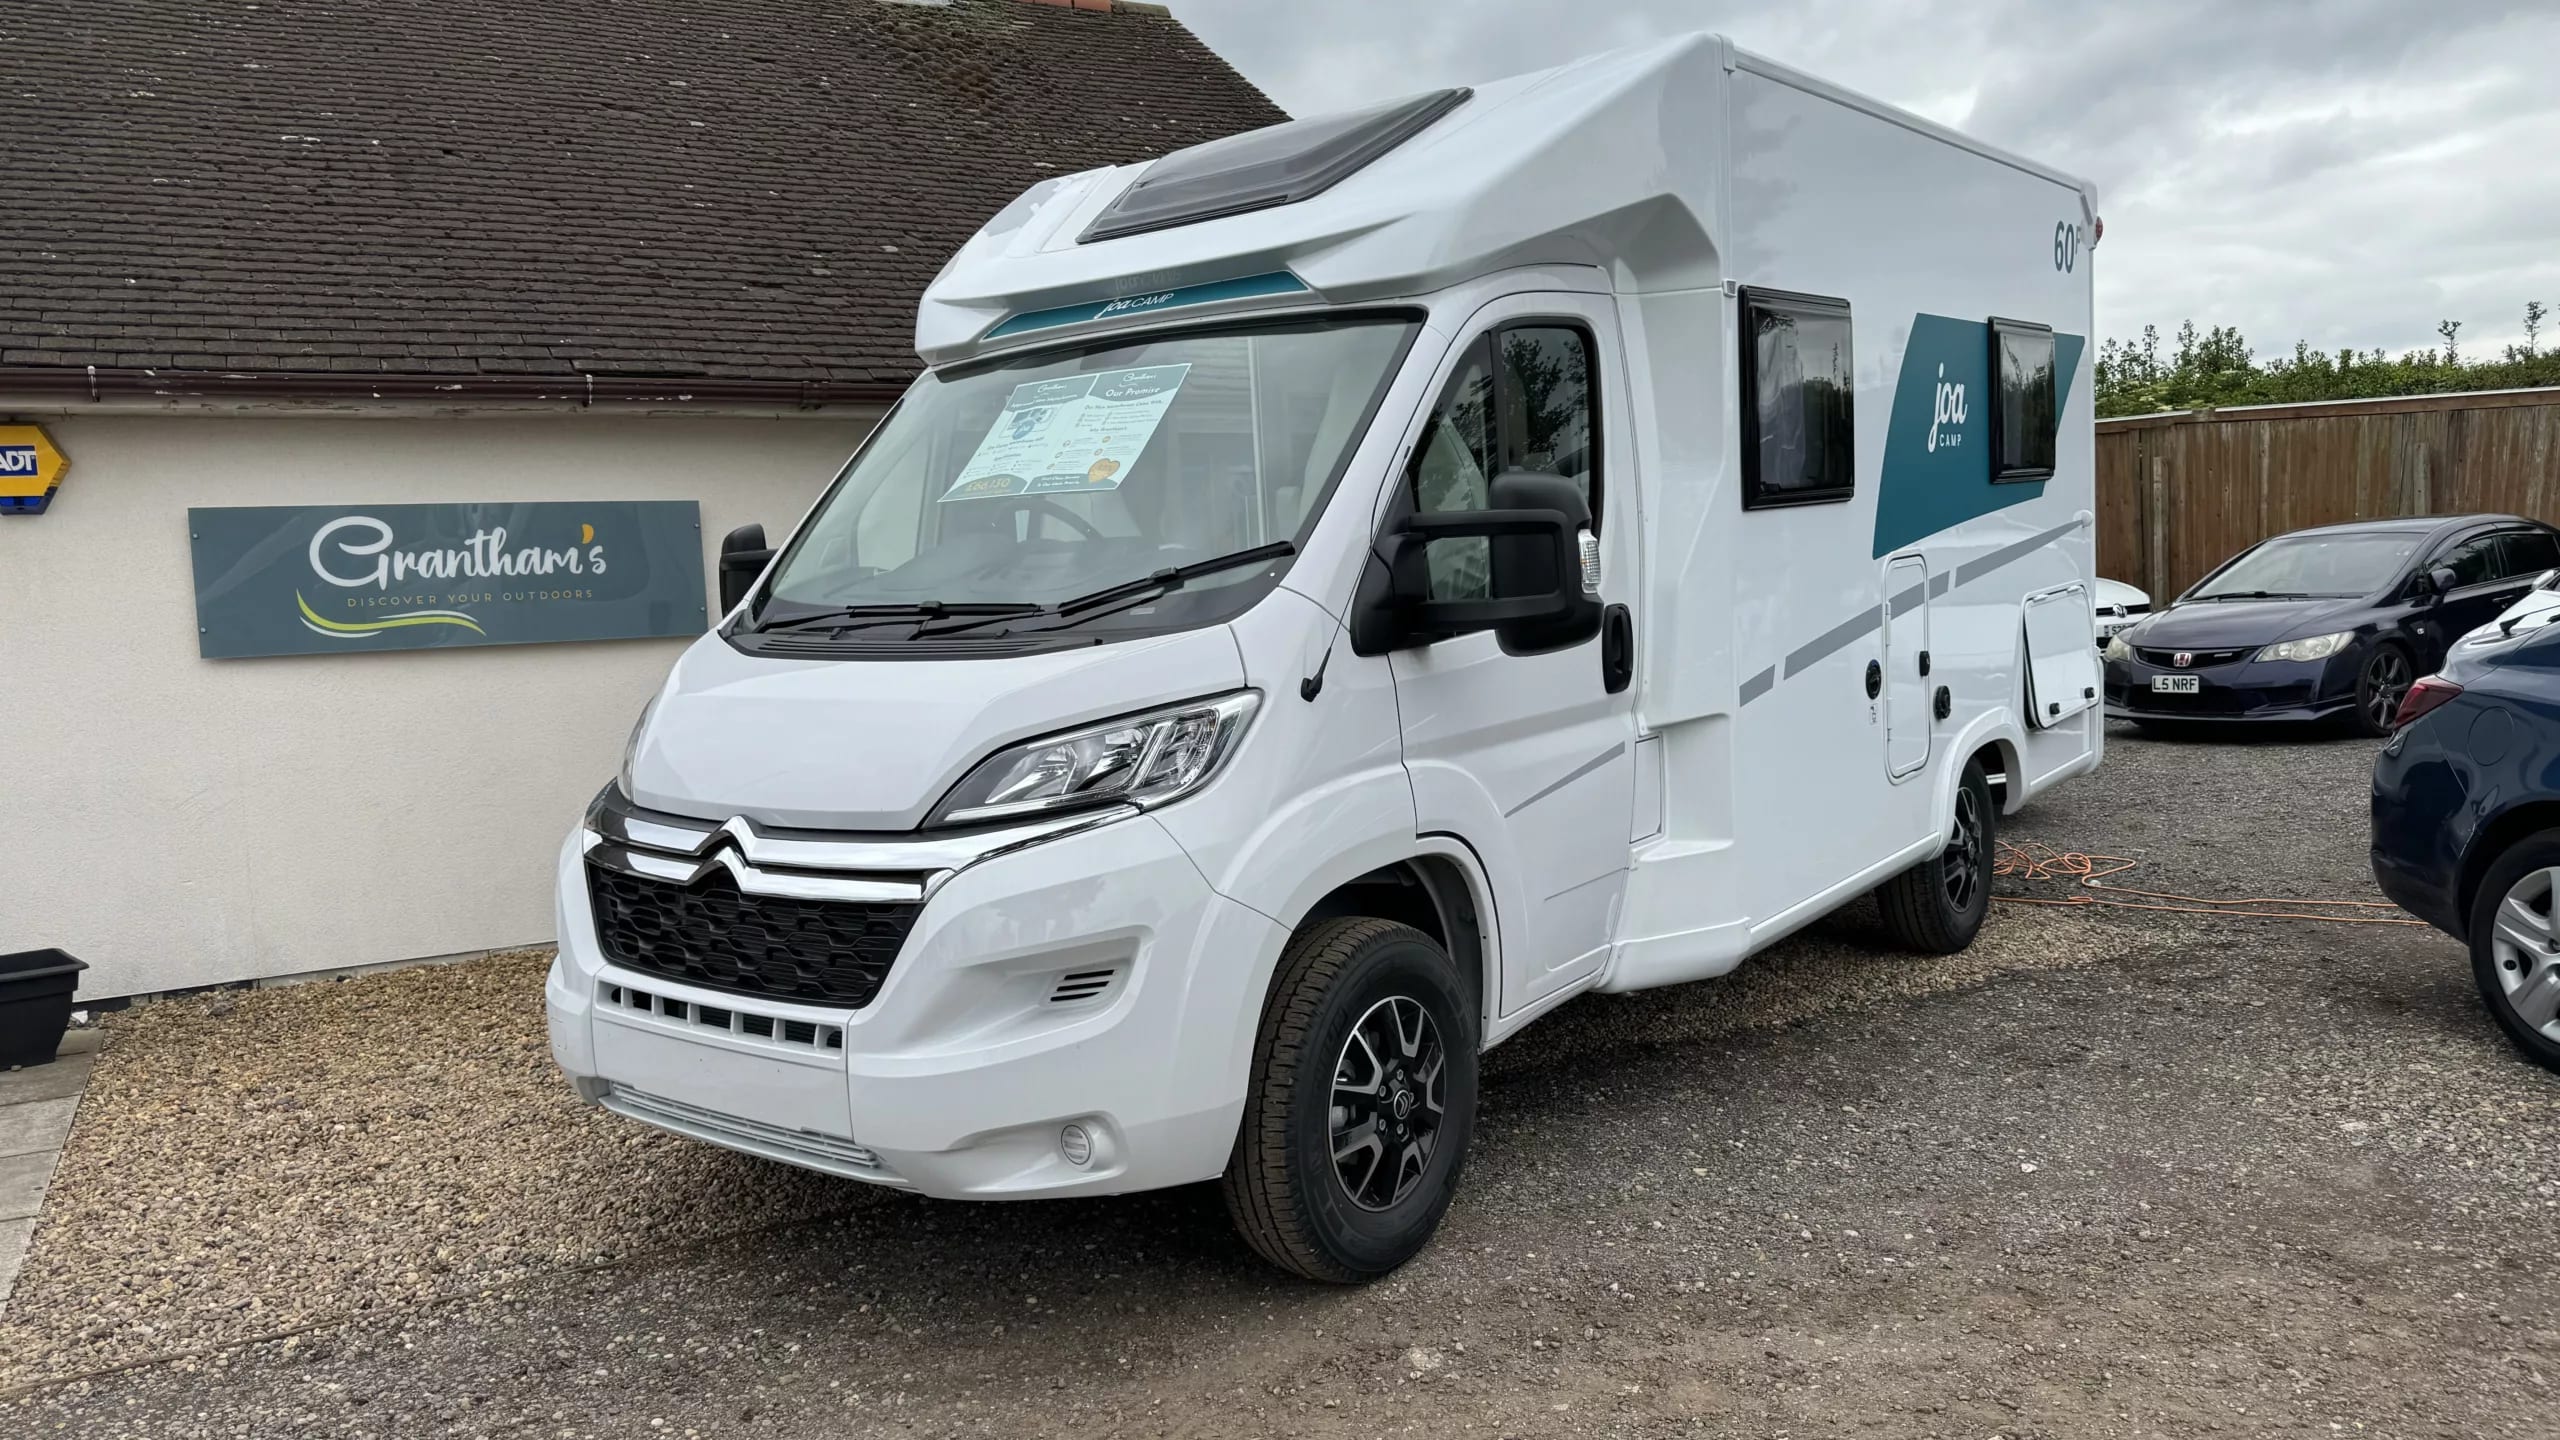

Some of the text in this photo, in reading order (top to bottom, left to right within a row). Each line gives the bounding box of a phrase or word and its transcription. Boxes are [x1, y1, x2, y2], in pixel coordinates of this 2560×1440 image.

[1131, 293, 1175, 308] CAMP
[1928, 362, 1968, 453] joa
[1939, 434, 1962, 447] CAMP
[309, 515, 607, 591] Grantham's
[347, 589, 593, 608] DISCOVER YOUR OUTDOORS
[2172, 677, 2197, 691] NRF
